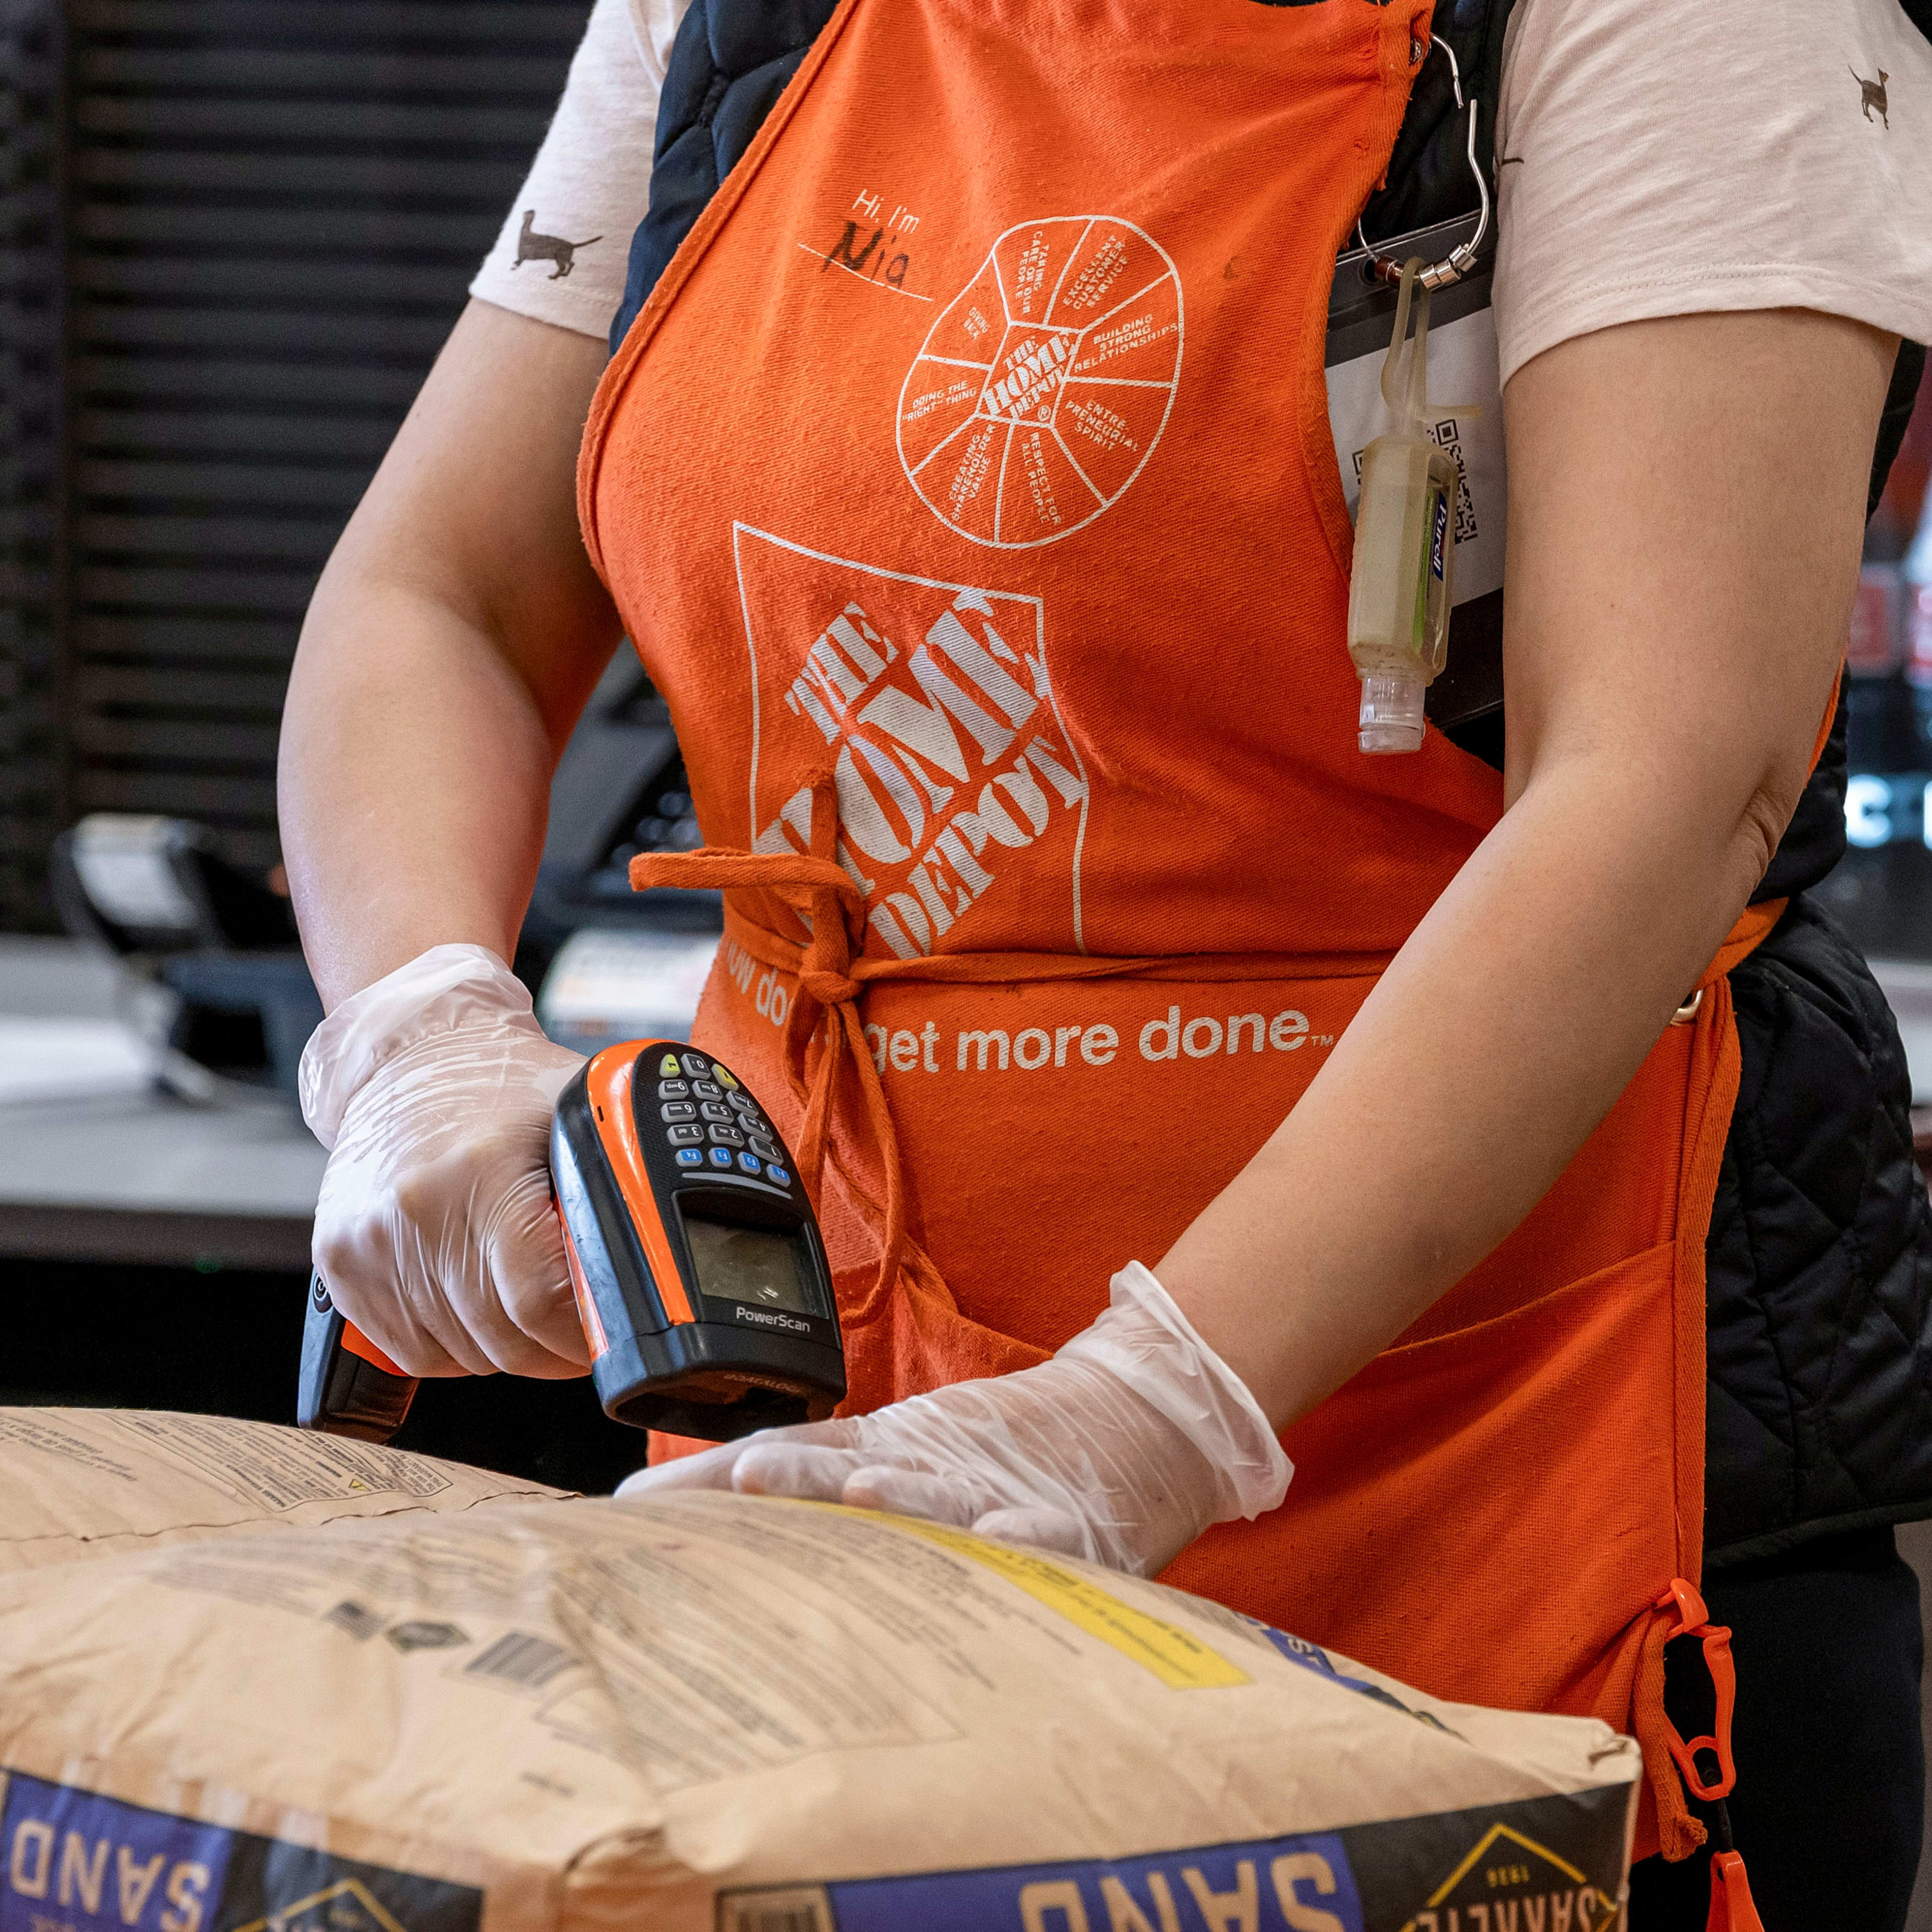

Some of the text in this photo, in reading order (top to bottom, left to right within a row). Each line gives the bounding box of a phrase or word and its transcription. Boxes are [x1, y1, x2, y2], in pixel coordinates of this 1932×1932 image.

[852, 189, 920, 234] Hi, I'm
[821, 221, 909, 290] Nia
[1015, 250, 1030, 299] PEOPLE
[1022, 231, 1043, 314] CARE OF OUR
[1033, 244, 1050, 291] TAKING
[1063, 235, 1117, 305] EXCELLENT
[1073, 241, 1125, 309] CUSTOMER
[1087, 255, 1128, 307] SERVICE
[963, 318, 980, 341] BACK
[969, 306, 991, 334] GIVING
[1093, 314, 1153, 345] BUILDING
[1099, 325, 1151, 352] STRONG
[1002, 336, 1039, 371] THE
[1074, 323, 1178, 373] RELATIONSHIPS
[982, 329, 1078, 417] HOME
[913, 380, 969, 409] DOING THE
[945, 388, 977, 406] THING
[1008, 364, 1065, 422] DEPOT
[1065, 400, 1139, 452] PRENEURIAL
[1075, 421, 1115, 451] SPIRIT
[949, 434, 981, 501] CREATING
[951, 424, 996, 521] SHAREHOLDER
[969, 457, 991, 499] VALUE
[1021, 442, 1050, 524] ALL PEOPLE
[1030, 432, 1063, 525] RESPECT FOR
[1433, 504, 1446, 572] Purell
[784, 601, 899, 745] THE
[868, 736, 1088, 961] DEPOT
[727, 942, 756, 995] ow
[864, 1021, 940, 1076] get
[957, 1022, 1119, 1072] more
[1139, 1006, 1310, 1060] done
[677, 1082, 685, 1091] 9
[710, 1085, 718, 1094] 8
[746, 1100, 753, 1108] 7
[684, 1104, 692, 1113] 6
[720, 1106, 728, 1115] 5
[759, 1122, 766, 1132] 4
[691, 1126, 699, 1136] 3
[730, 1129, 738, 1139] 2
[686, 1151, 697, 1160] F4
[717, 1151, 728, 1160] F3
[746, 1157, 757, 1166] F2
[770, 1146, 777, 1156] 1
[776, 1169, 786, 1178] F1
[736, 1306, 811, 1333] PowerScan
[10, 1817, 210, 1932] SAND
